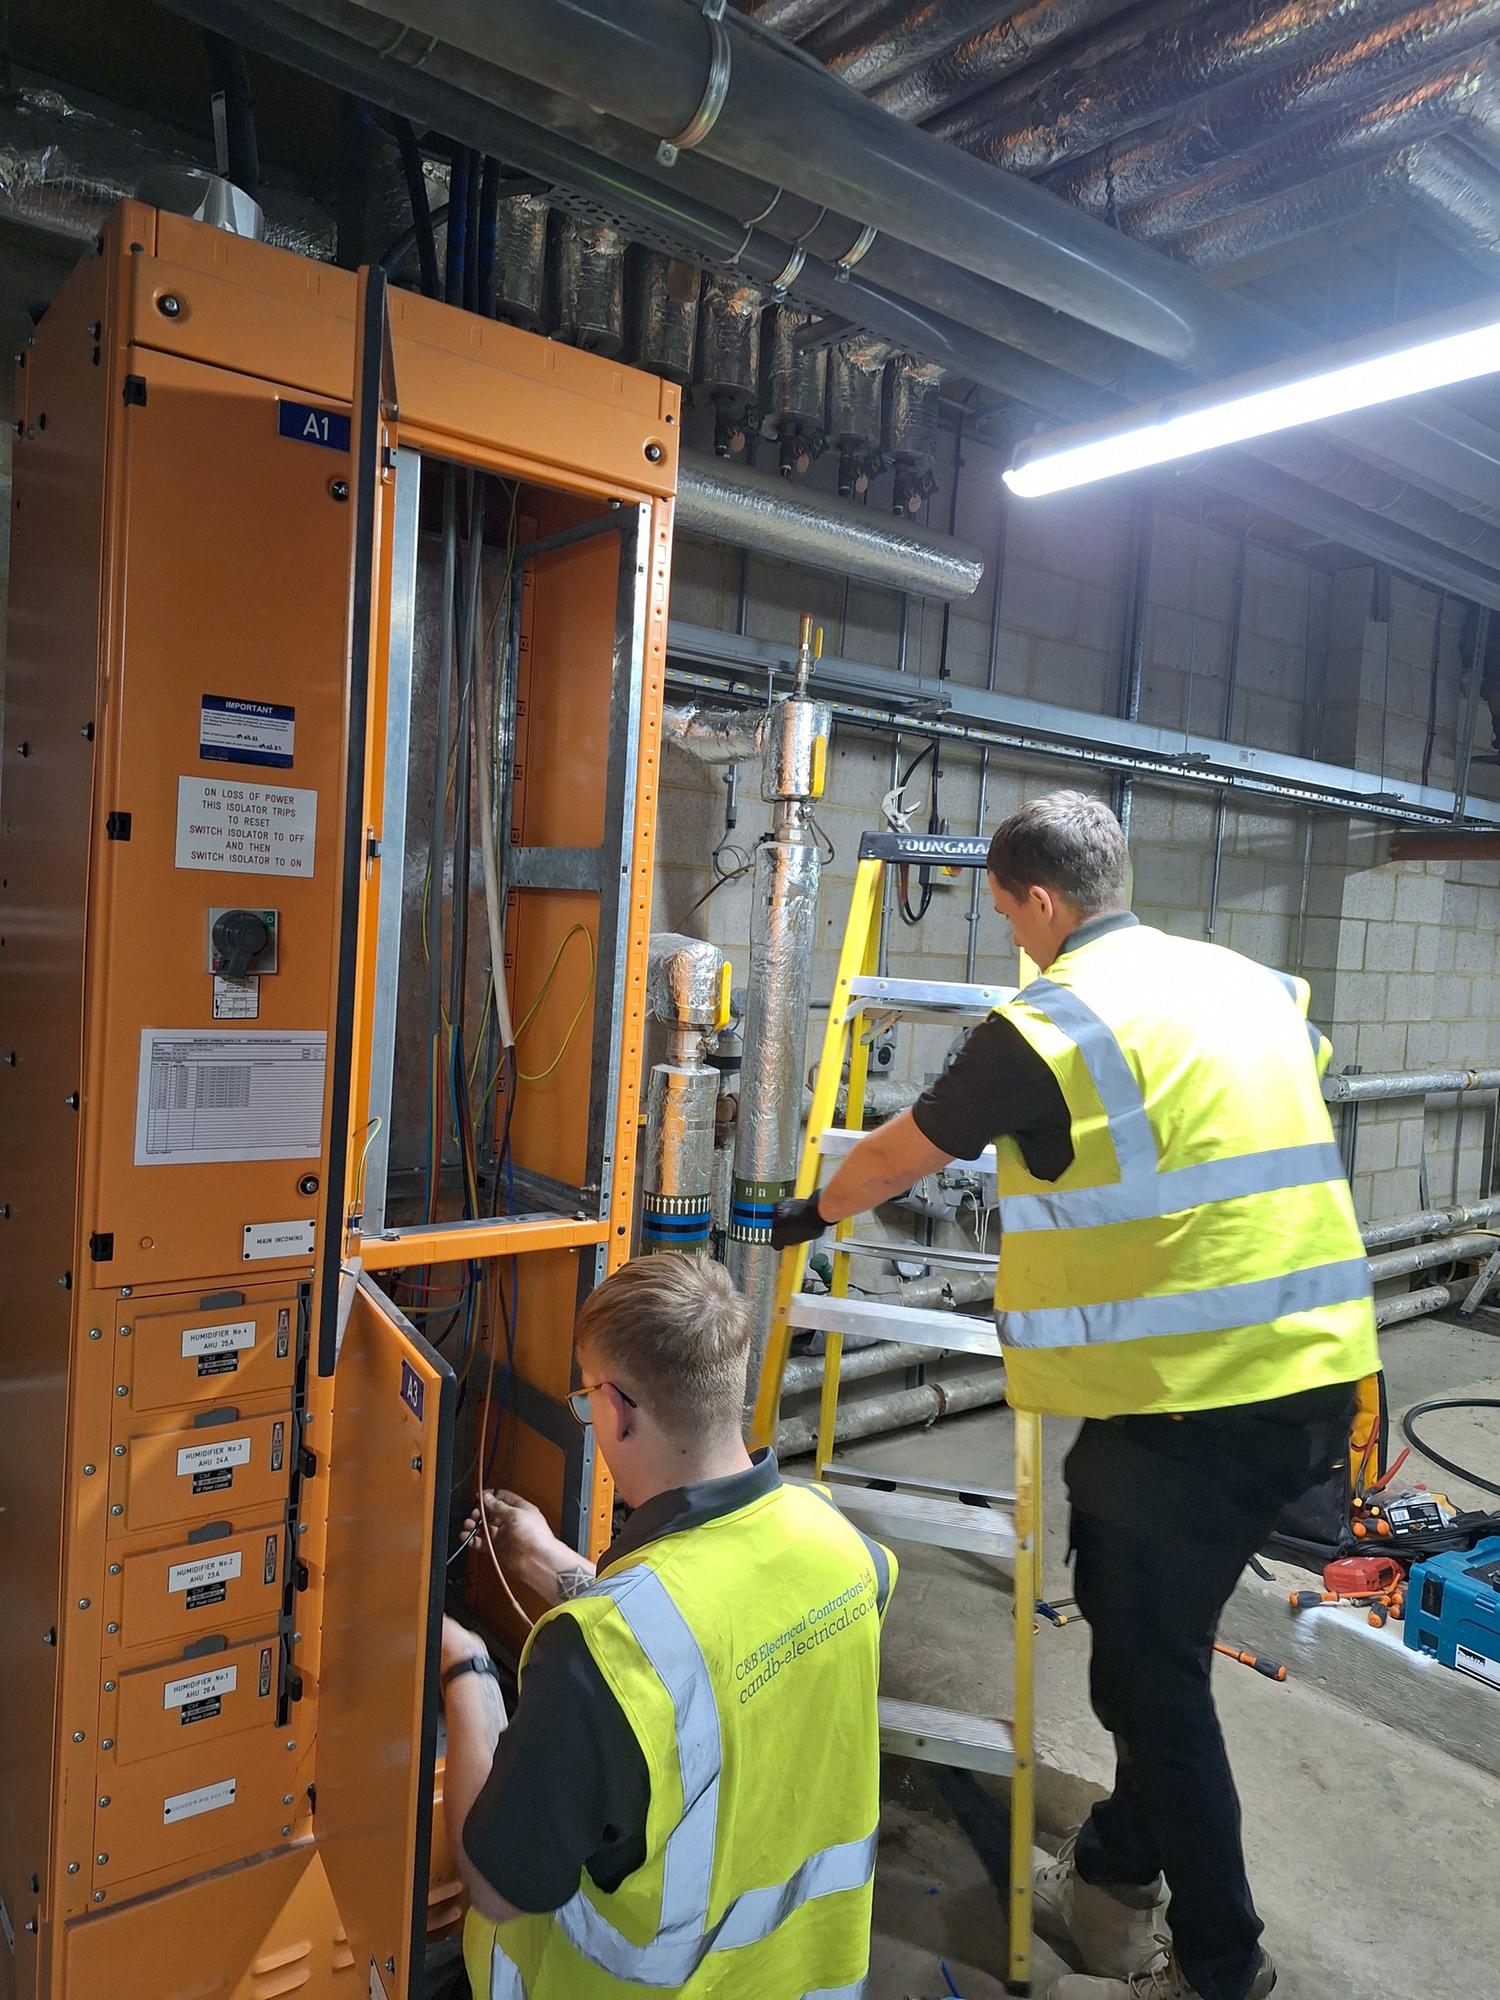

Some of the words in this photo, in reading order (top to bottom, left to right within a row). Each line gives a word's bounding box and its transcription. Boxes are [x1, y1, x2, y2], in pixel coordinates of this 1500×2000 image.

[302, 412, 329, 441] A1
[225, 701, 274, 714] IMPORTANT
[204, 788, 217, 797] ON
[222, 789, 244, 800] LOSS
[249, 792, 260, 801] OF
[265, 794, 295, 805] POWER
[202, 800, 222, 810] THIS
[226, 802, 268, 815] ISOLATOR
[272, 807, 296, 818] TRIPS
[228, 816, 239, 825] TO
[244, 817, 270, 827] RESET
[189, 825, 223, 836] SWITCH
[228, 828, 269, 840] ISOLATOR
[274, 832, 284, 842] TO
[289, 834, 305, 843] OFF
[225, 841, 244, 851] AND
[249, 843, 271, 853] THEN
[191, 851, 224, 861] SWITCH
[229, 854, 270, 865] ISOLATOR
[275, 857, 285, 867] TO
[290, 858, 302, 867] ON
[275, 1235, 304, 1243] INCOMING
[190, 1329, 230, 1341] HUMIDIFIER
[232, 1327, 247, 1335] No.4
[203, 1342, 218, 1350] AHU
[221, 1339, 235, 1348] 25A
[407, 1374, 418, 1408] A3
[185, 1448, 224, 1460] HUMIDIFIER
[198, 1460, 213, 1468] AHU
[216, 1456, 229, 1465] 24A
[176, 1563, 215, 1577] HUMIDIFIER
[218, 1558, 234, 1568] No.2
[189, 1576, 204, 1584] AHU
[207, 1570, 220, 1580] 23A
[735, 1653, 758, 1681] C&B
[758, 1616, 806, 1662] Electrical
[808, 1581, 864, 1625] Contractors
[860, 1568, 872, 1589] Ltd
[173, 1677, 212, 1693] HUMIDIFIER
[186, 1690, 200, 1699] AHU
[203, 1686, 216, 1695] 26A
